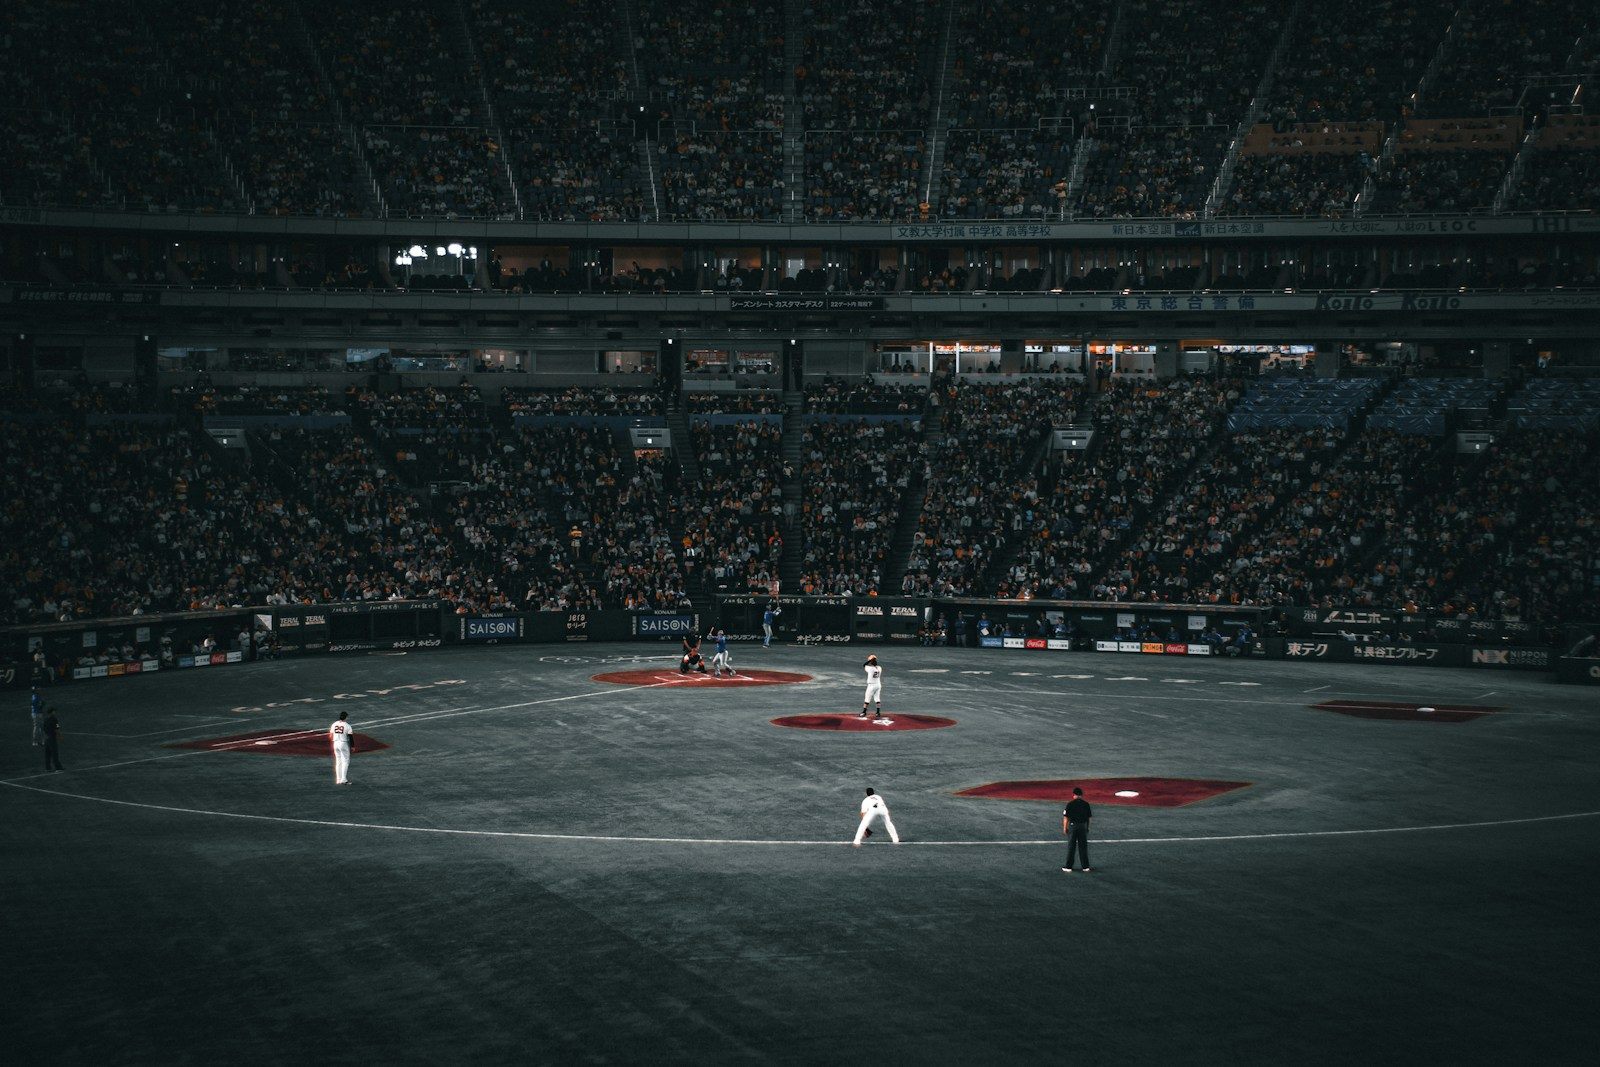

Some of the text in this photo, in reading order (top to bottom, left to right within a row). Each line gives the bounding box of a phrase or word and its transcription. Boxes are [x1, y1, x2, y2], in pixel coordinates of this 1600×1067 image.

[897, 225, 1051, 238] 文教大学付属 中学校 高等学校
[1112, 223, 1172, 235] 新日本空調
[1204, 222, 1265, 235] 新日本空調
[731, 300, 824, 308] シーズンシート カスタマーデスク
[1110, 296, 1256, 310] 東京総合警備
[469, 622, 516, 634] SAISON
[641, 619, 690, 631] SAISON
[1286, 642, 1328, 656] 東テク
[1362, 646, 1438, 660] 長谷工グループ
[1510, 650, 1548, 659] NIPPON
[334, 725, 345, 734] 29
